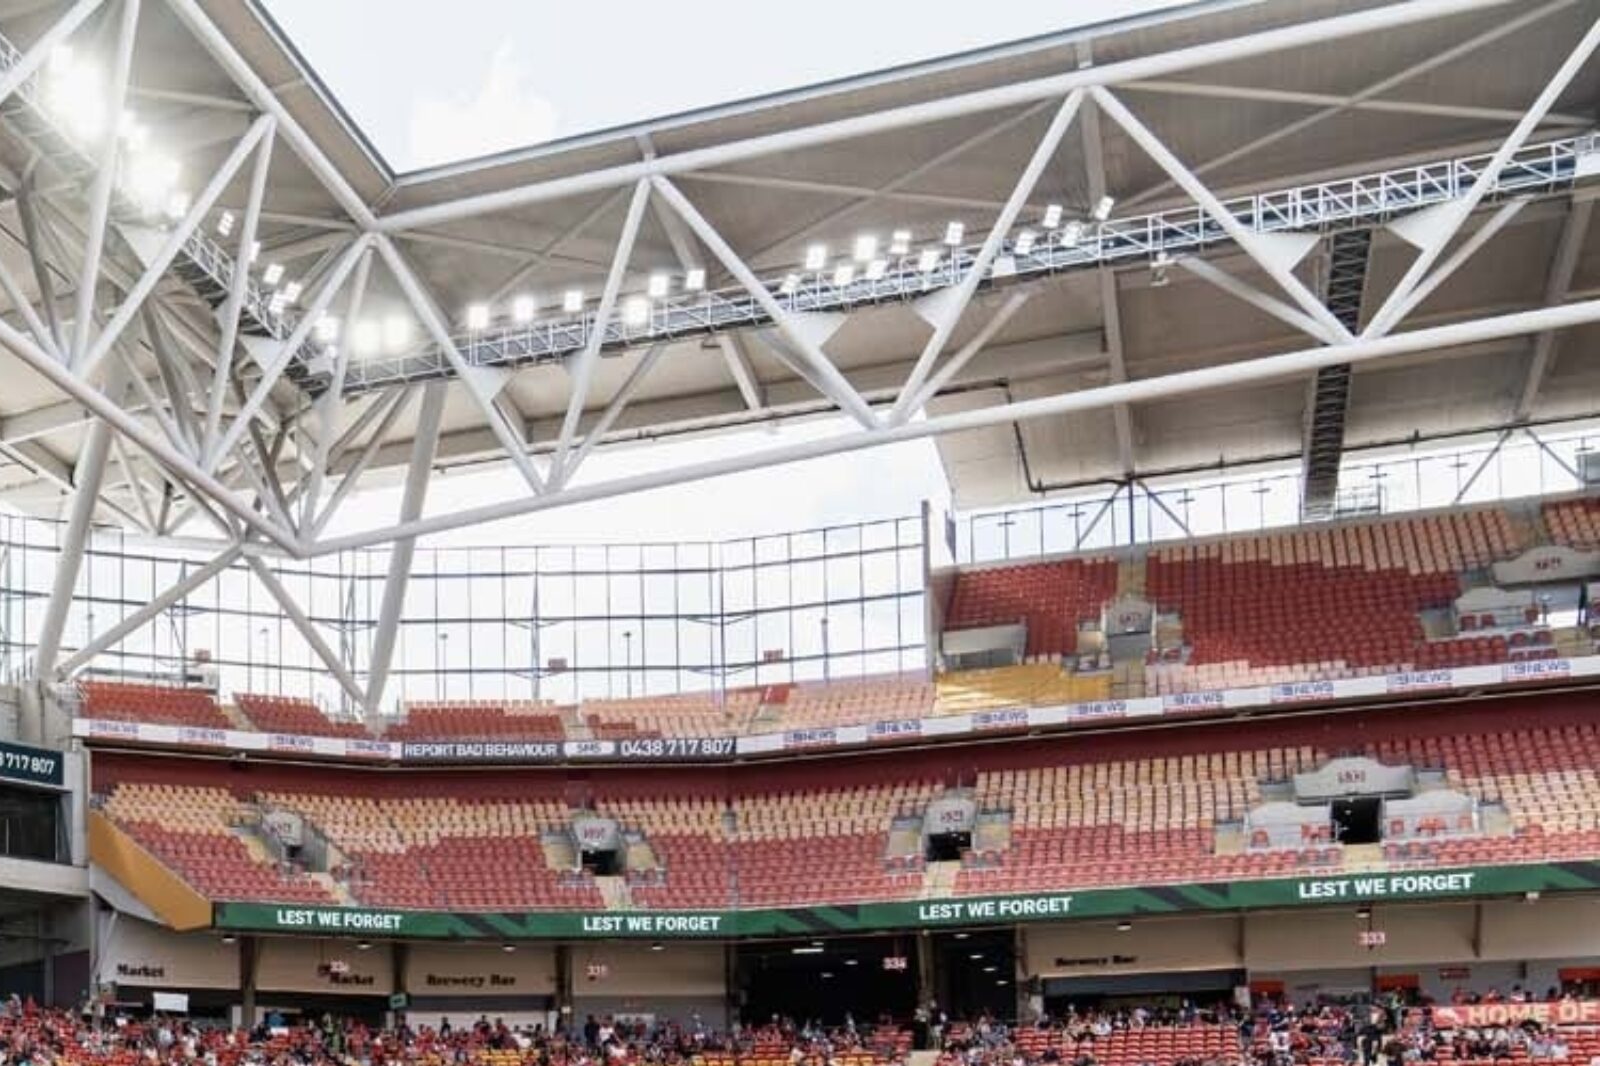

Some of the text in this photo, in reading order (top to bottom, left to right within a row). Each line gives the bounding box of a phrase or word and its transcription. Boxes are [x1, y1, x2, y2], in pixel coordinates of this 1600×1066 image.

[404, 742, 559, 758] REPORT BAD BEHAVIOUR
[620, 738, 733, 757] 0438 717 807
[5, 752, 31, 770] 717
[31, 757, 56, 776] 807
[1299, 874, 1475, 899] LEST WE FORGET
[919, 896, 1072, 920] LEST WE FORGET
[277, 908, 402, 930] LEST WE FORGET
[583, 916, 720, 933] LEST WE FORGET
[116, 963, 165, 978] Market
[329, 972, 375, 987] Market
[426, 973, 485, 988] Brewery
[1469, 1001, 1599, 1026] HOME OF
